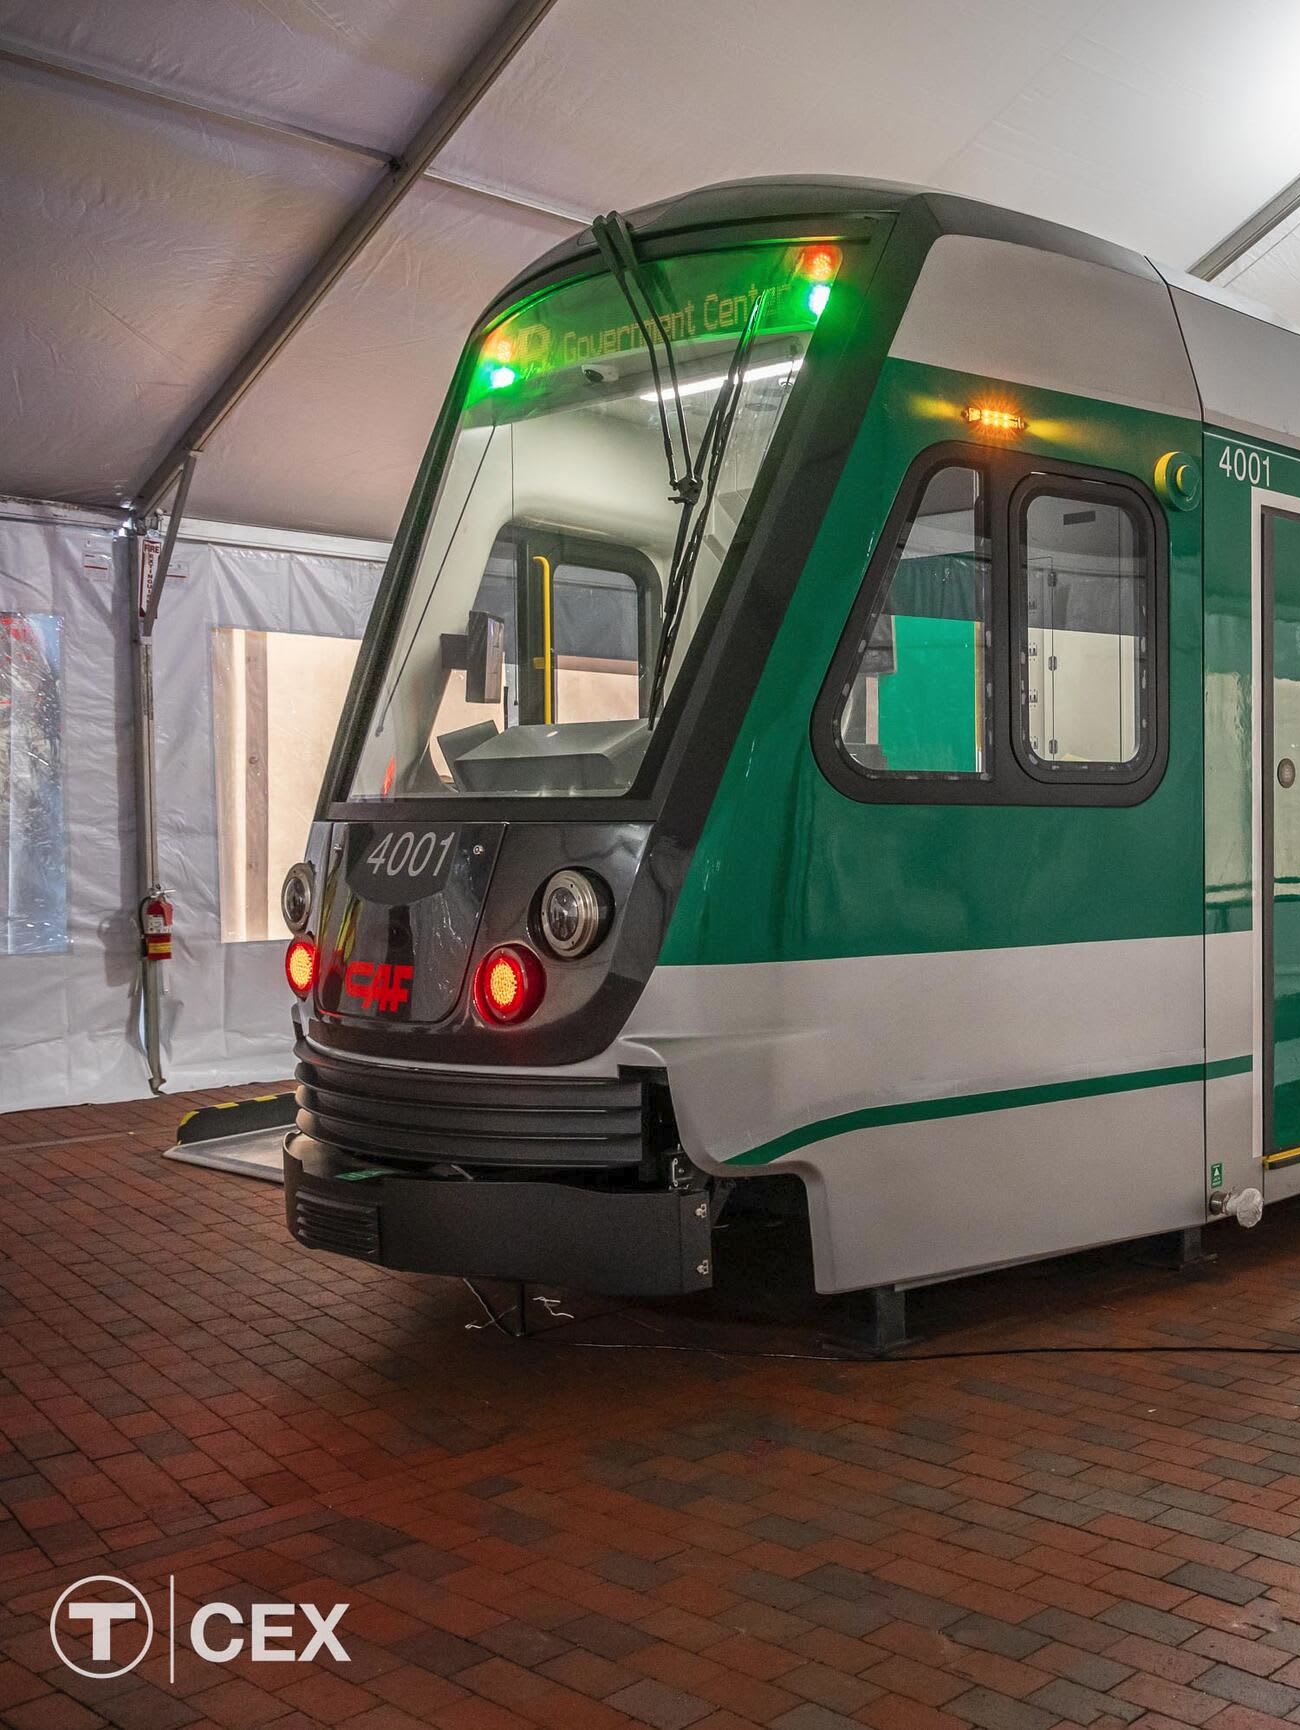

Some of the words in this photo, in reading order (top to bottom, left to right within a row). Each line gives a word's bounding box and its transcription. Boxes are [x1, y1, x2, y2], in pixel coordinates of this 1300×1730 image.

[564, 301, 695, 363] Government
[1219, 446, 1270, 487] 4001
[144, 544, 160, 554] FIRE
[366, 831, 456, 877] 4001
[346, 961, 414, 1012] CAF
